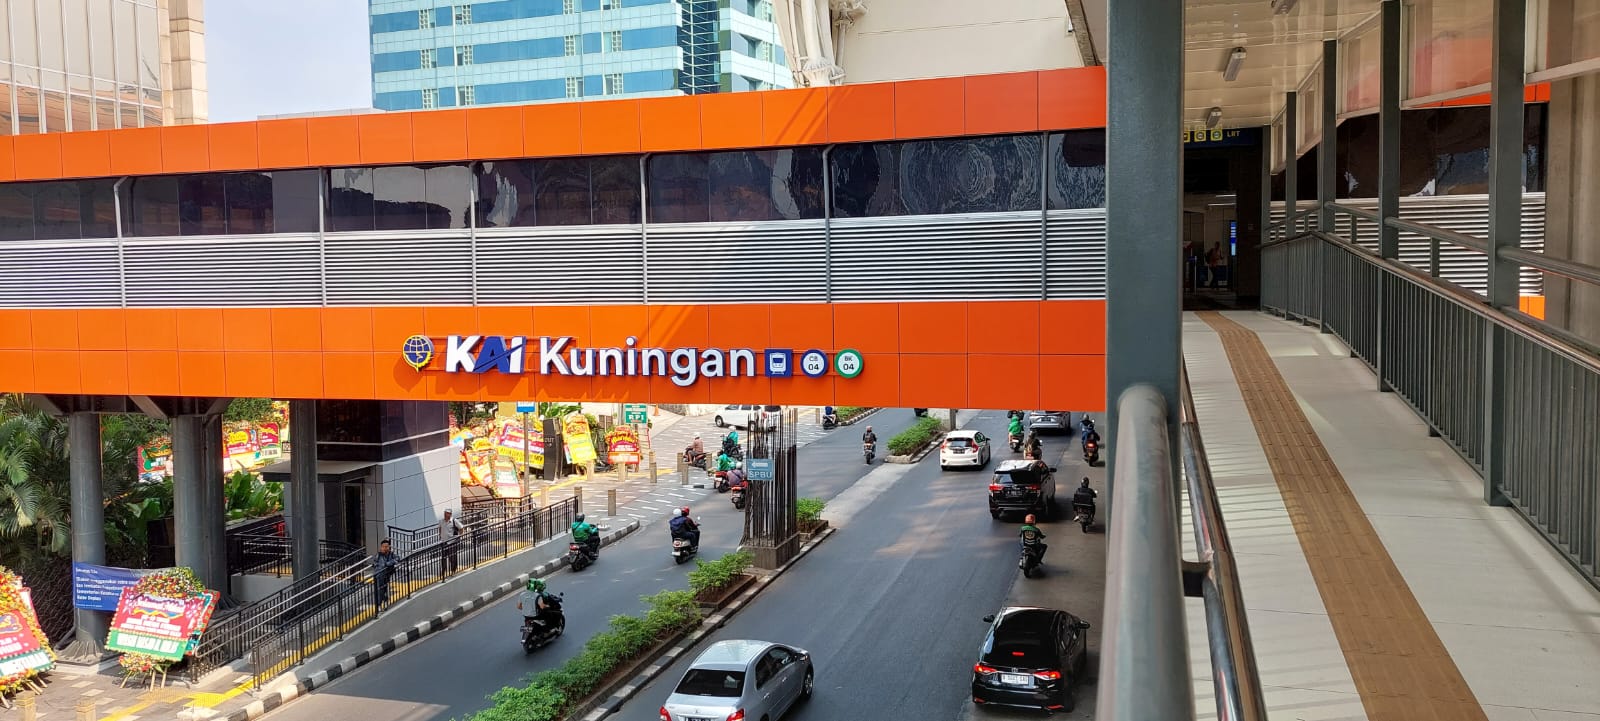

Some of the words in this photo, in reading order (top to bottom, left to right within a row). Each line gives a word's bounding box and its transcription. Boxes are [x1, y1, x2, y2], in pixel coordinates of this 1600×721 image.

[446, 335, 526, 373] KAI
[539, 336, 756, 387] Kuningan
[749, 470, 772, 478] SPBU
